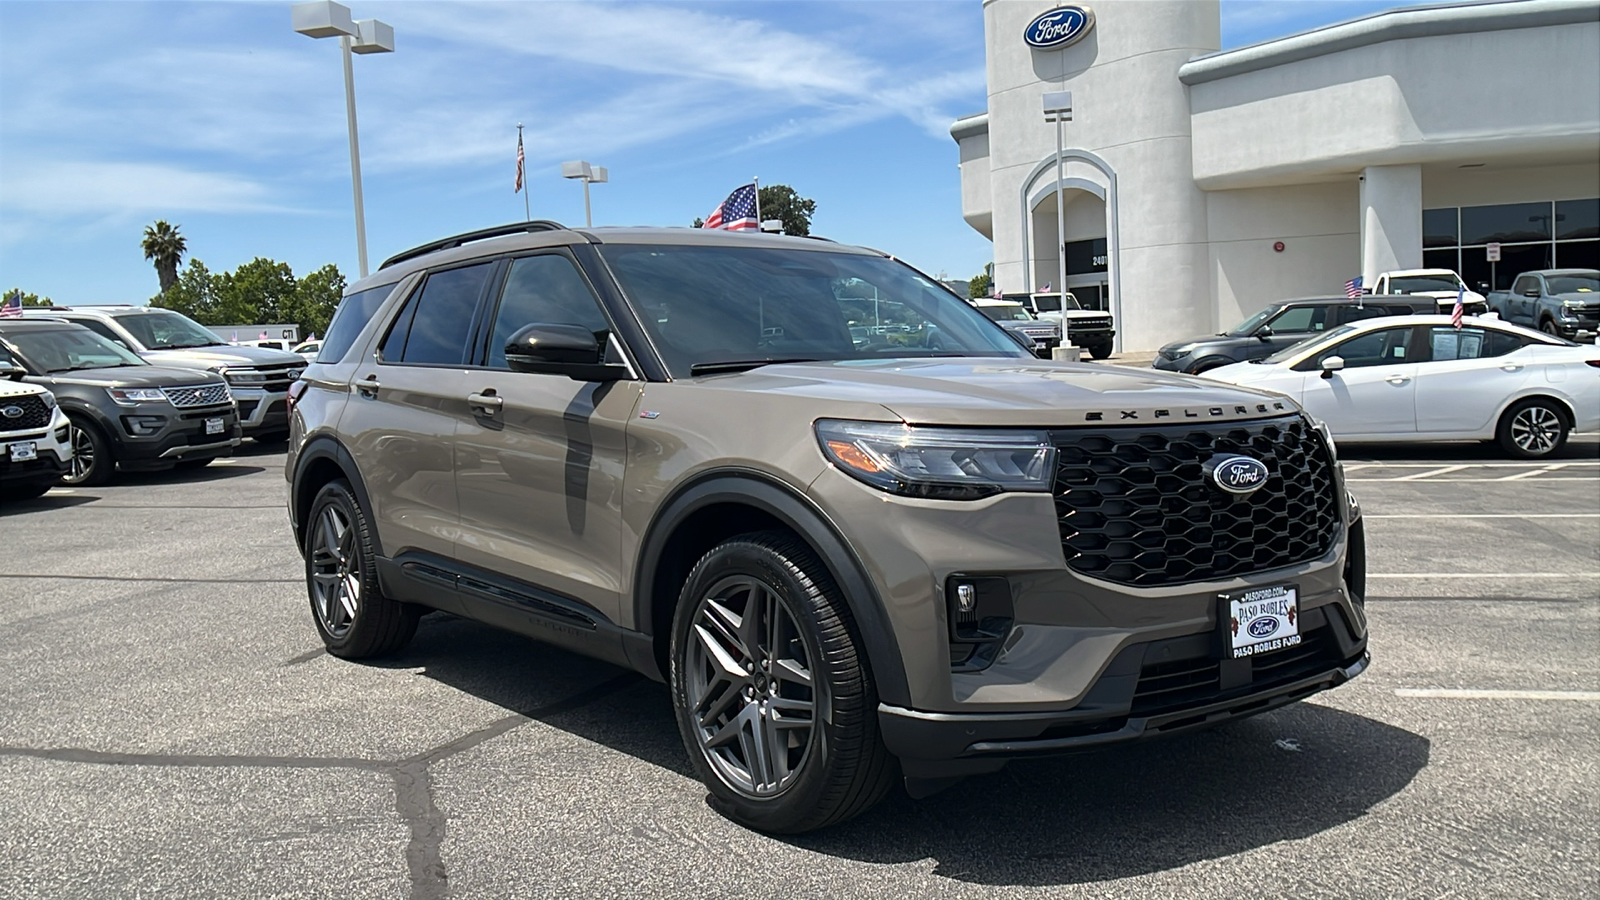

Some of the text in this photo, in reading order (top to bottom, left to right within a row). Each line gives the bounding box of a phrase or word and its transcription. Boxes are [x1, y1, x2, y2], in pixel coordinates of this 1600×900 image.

[1035, 14, 1073, 42] Ford
[1085, 402, 1285, 421] EXPLORER
[1230, 464, 1261, 485] Ford
[1239, 599, 1288, 625] PASO ROBLES
[1253, 619, 1274, 635] Ford
[1233, 635, 1301, 658] PASO ROBLES FORD
